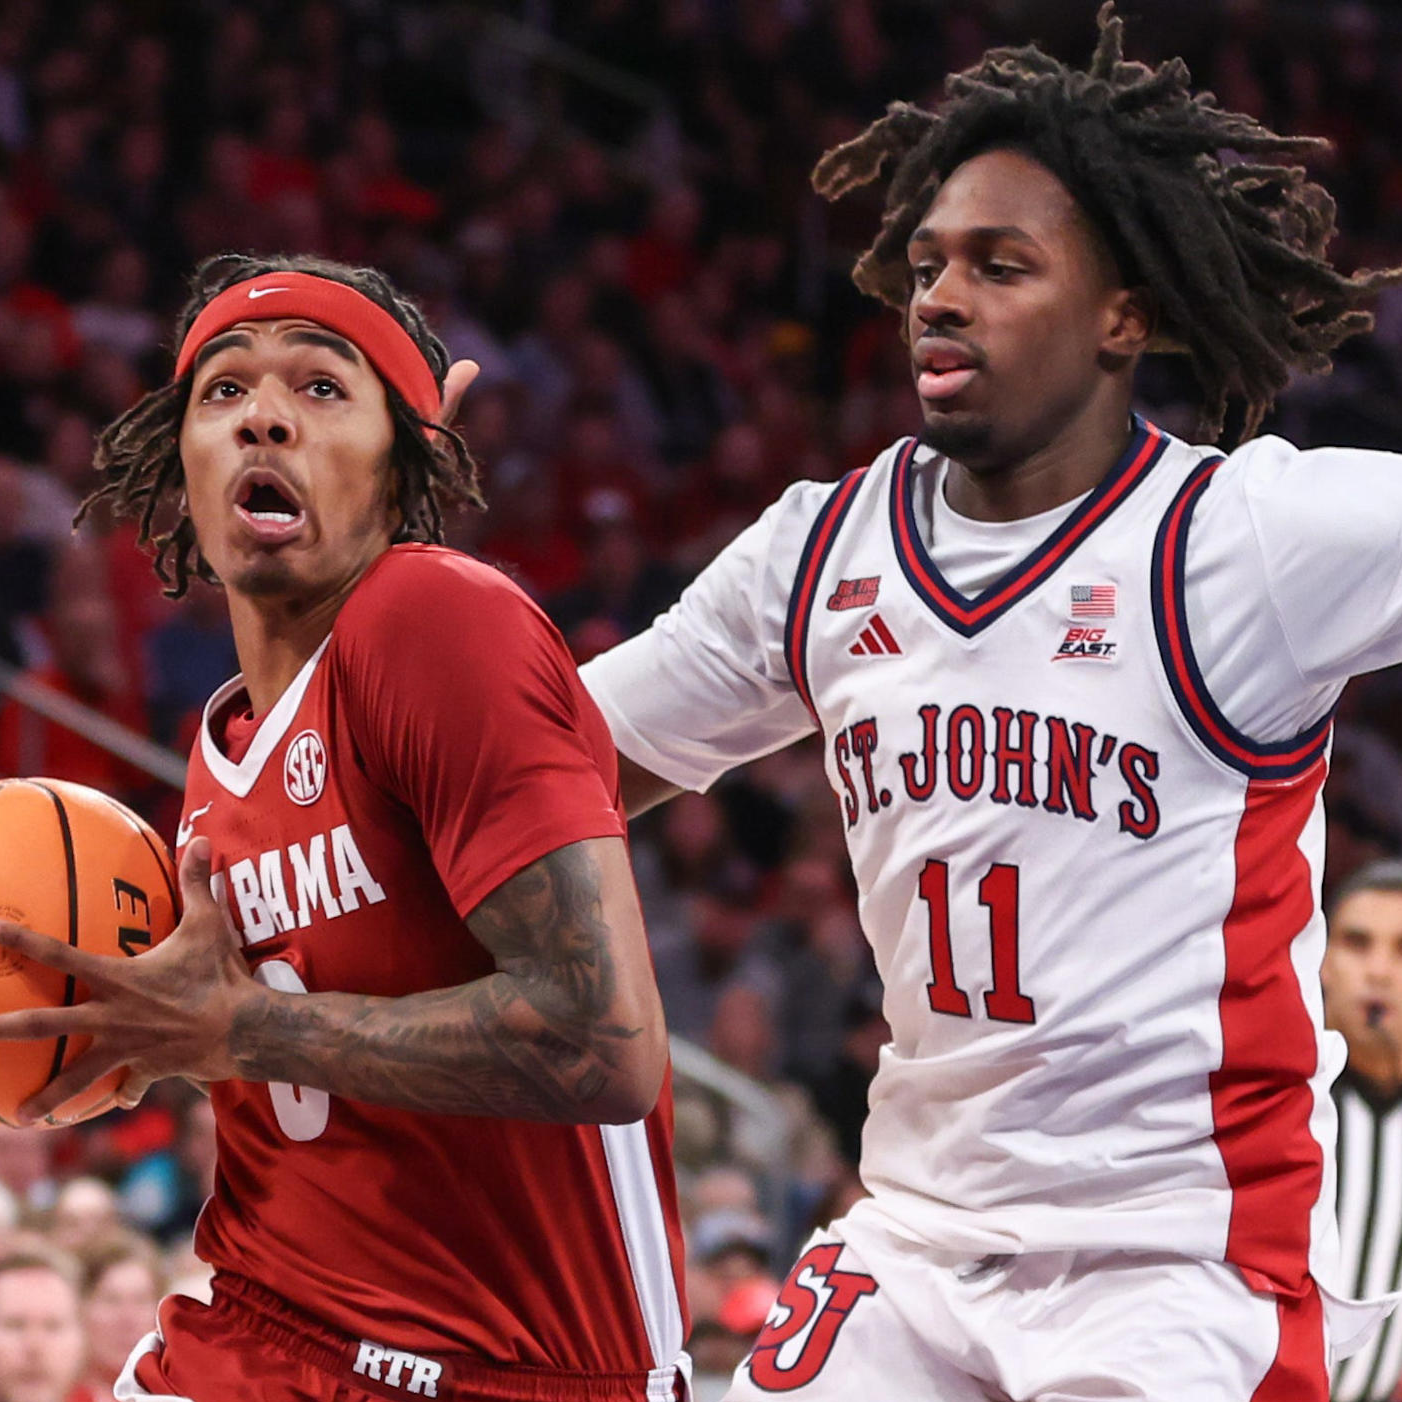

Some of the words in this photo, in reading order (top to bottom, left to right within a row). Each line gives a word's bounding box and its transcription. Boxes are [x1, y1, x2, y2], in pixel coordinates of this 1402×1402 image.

[1057, 642, 1117, 656] EAST
[1064, 628, 1107, 642] BIG
[286, 734, 325, 800] SEC
[834, 716, 892, 832] ST.
[899, 704, 1160, 841] JOHN'S
[210, 823, 387, 948] BAMA
[919, 858, 1036, 1026] 11
[353, 1338, 444, 1399] RTR
